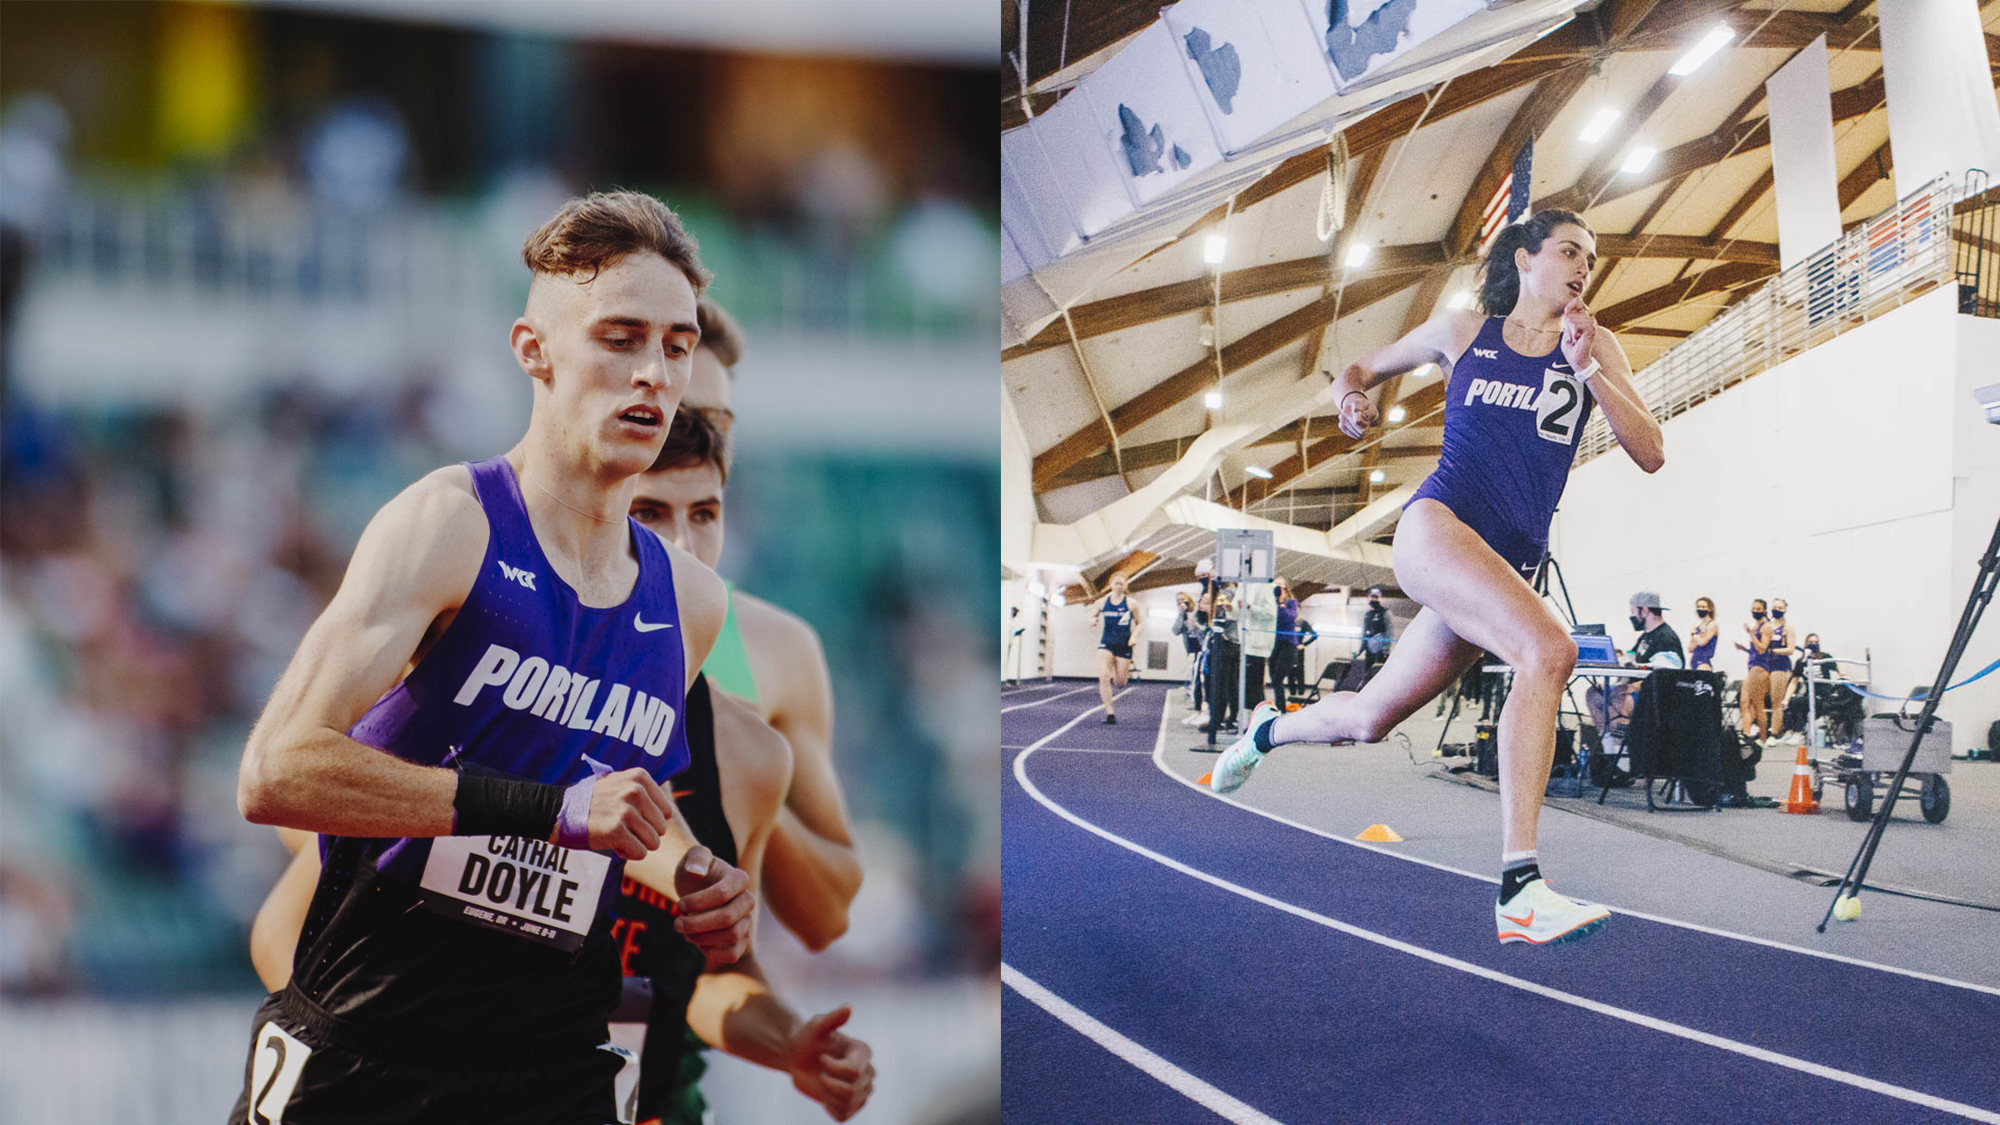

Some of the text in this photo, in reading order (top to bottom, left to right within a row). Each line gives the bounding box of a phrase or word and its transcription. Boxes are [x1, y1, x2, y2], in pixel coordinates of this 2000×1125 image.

[1473, 347, 1499, 360] WCC
[1541, 380, 1577, 436] 2
[498, 560, 536, 591] WCC
[453, 643, 676, 757] PORTLAND
[487, 835, 569, 875] CATHAL
[457, 853, 579, 923] DOYLE
[463, 906, 495, 922] EUGENE,
[495, 915, 509, 926] OR
[520, 922, 543, 936] JUNE
